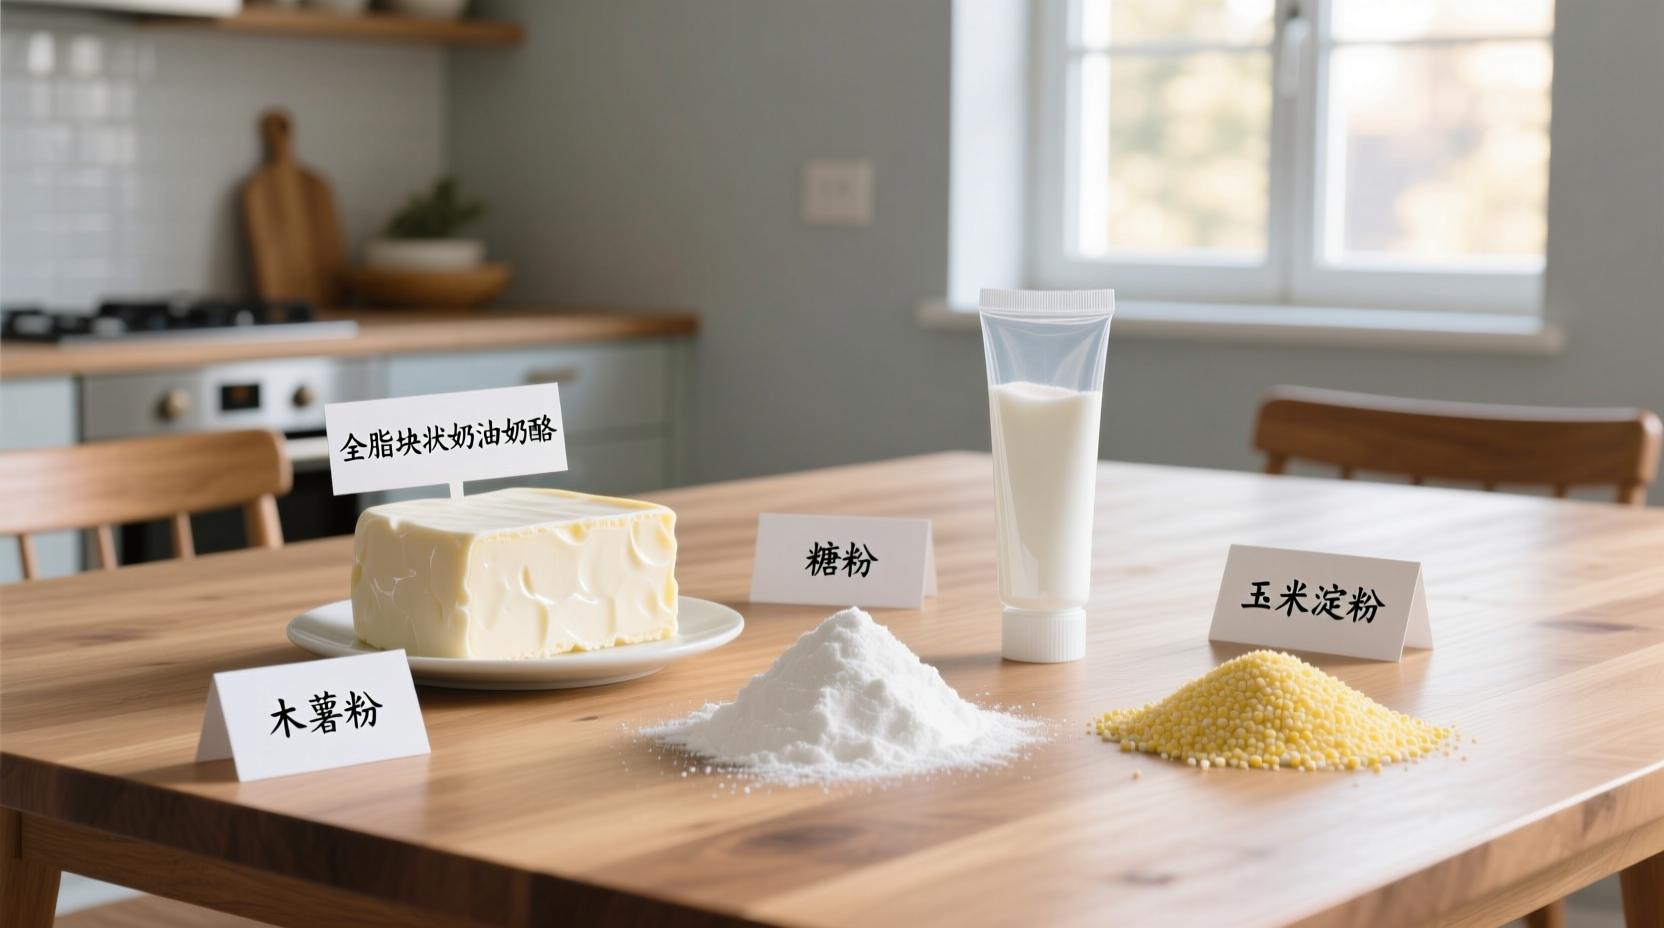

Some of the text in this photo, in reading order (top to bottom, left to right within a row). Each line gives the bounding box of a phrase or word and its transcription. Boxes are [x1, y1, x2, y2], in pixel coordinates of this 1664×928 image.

[340, 414, 557, 462] 全脂块状奶油奶酪
[804, 541, 879, 578] 糖粉
[1241, 579, 1386, 624] 玉米淀粉
[270, 690, 383, 739] 木薯粉
